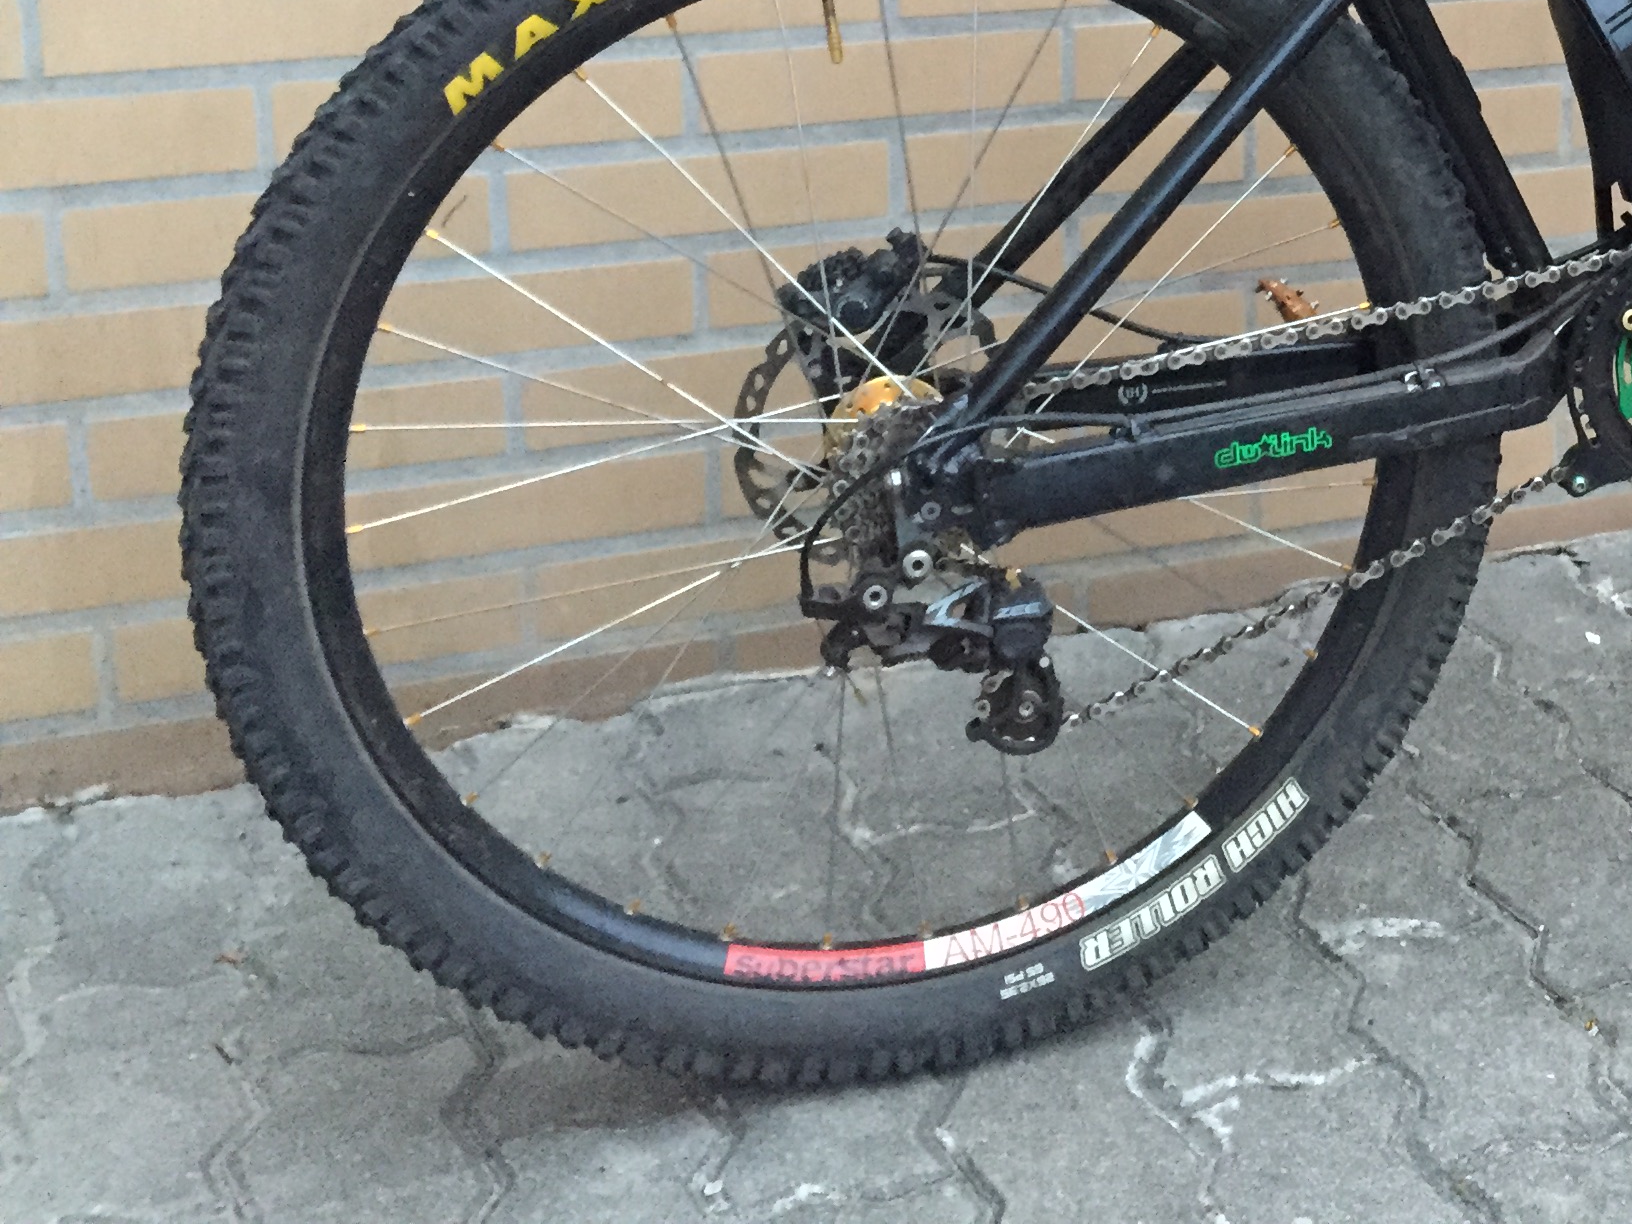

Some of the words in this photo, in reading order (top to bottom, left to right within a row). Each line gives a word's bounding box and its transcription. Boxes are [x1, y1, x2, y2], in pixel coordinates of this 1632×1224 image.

[1221, 776, 1310, 873] HIGH
[735, 950, 917, 984] superstar
[945, 892, 1085, 966] AM-490
[1079, 854, 1227, 971] ROLLER
